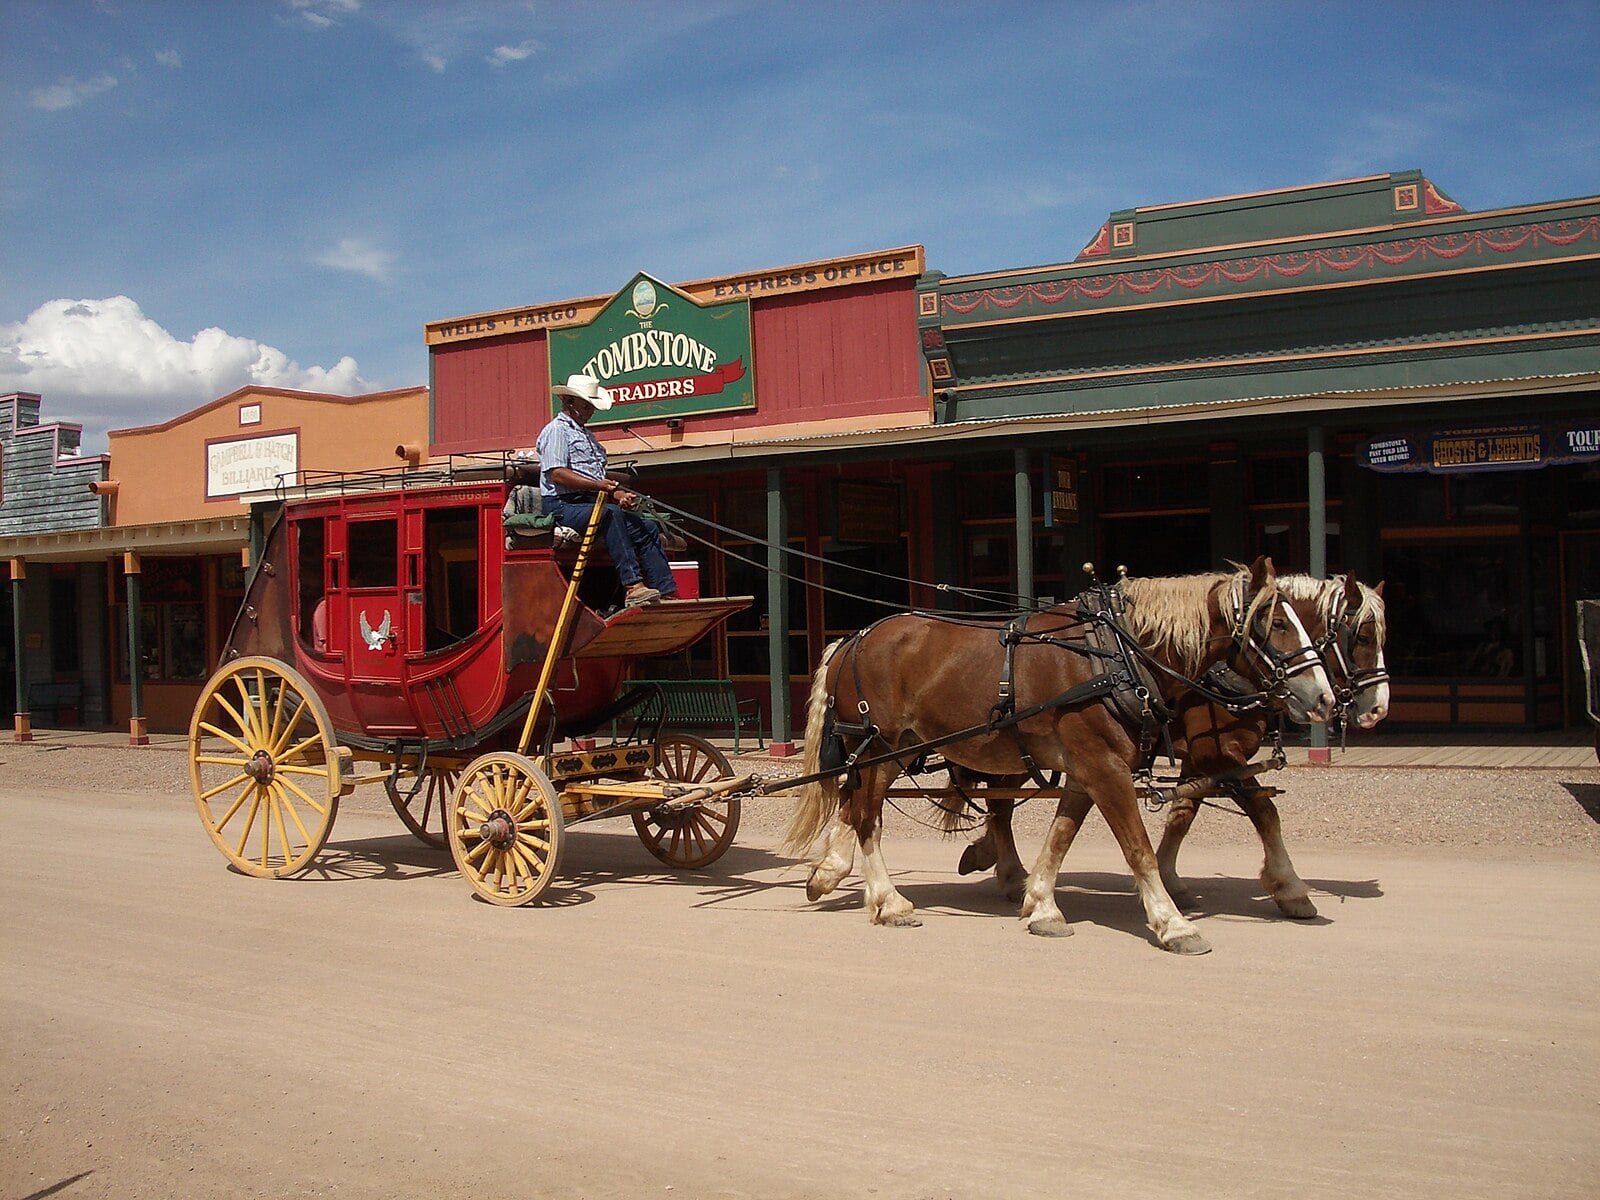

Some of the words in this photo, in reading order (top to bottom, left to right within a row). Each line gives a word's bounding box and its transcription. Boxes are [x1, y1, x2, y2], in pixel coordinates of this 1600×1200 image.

[714, 270, 817, 297] EXPRESS
[823, 258, 906, 282] OFFICE
[440, 319, 497, 338] WELLS
[513, 306, 578, 328] FARGO
[639, 321, 653, 330] THE
[582, 329, 717, 380] TOMBSTONE
[607, 379, 695, 403] TRADERS
[1433, 439, 1476, 465] GHOSTS
[1478, 442, 1487, 458] &
[1488, 434, 1541, 462] LEGENDS
[1572, 445, 1599, 453] ENTRANCE
[222, 465, 280, 489] BILLIARDS
